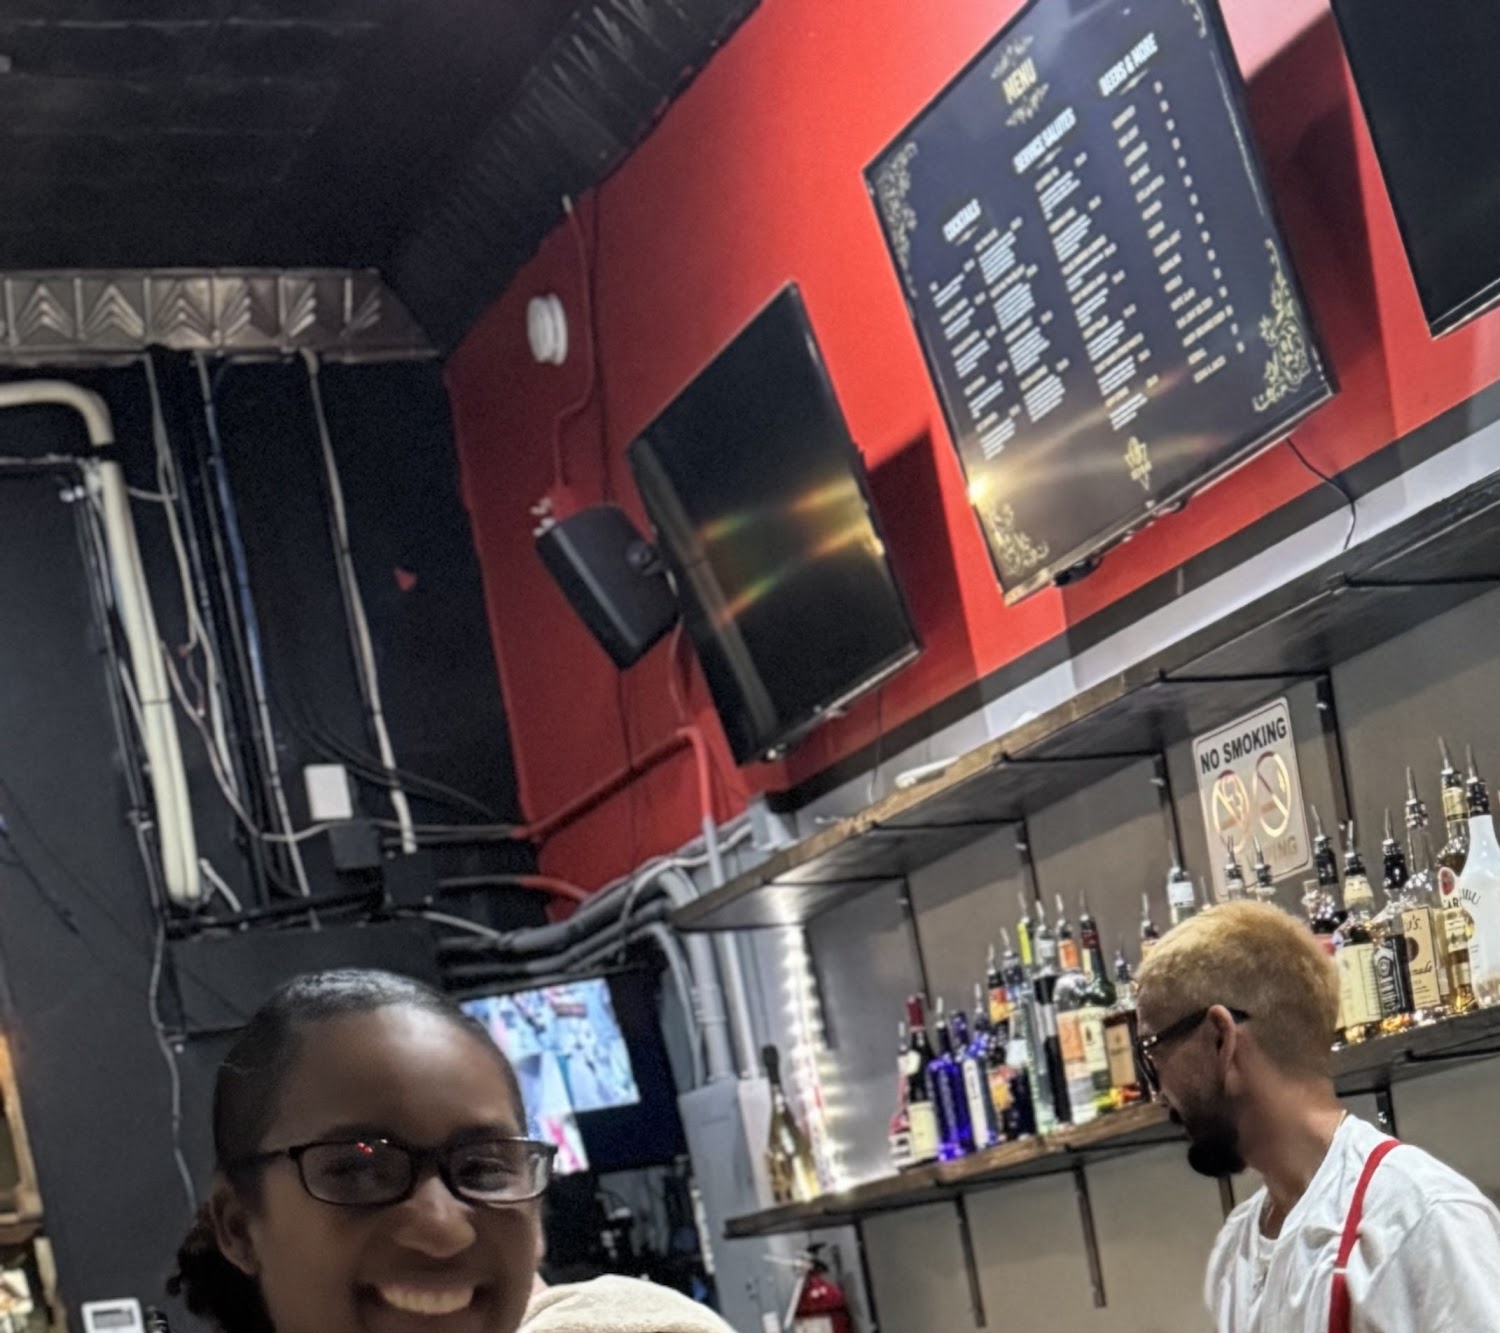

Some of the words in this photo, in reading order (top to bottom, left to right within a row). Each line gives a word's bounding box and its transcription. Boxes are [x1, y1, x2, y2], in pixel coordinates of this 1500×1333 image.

[1002, 57, 1037, 104] MENU
[1098, 60, 1128, 97] BEERS
[1131, 33, 1159, 68] MORE
[1013, 134, 1048, 174] SERVICE
[942, 198, 982, 242] COCKTAILS
[1200, 747, 1220, 775] NO
[1222, 716, 1288, 764] SMOKING
